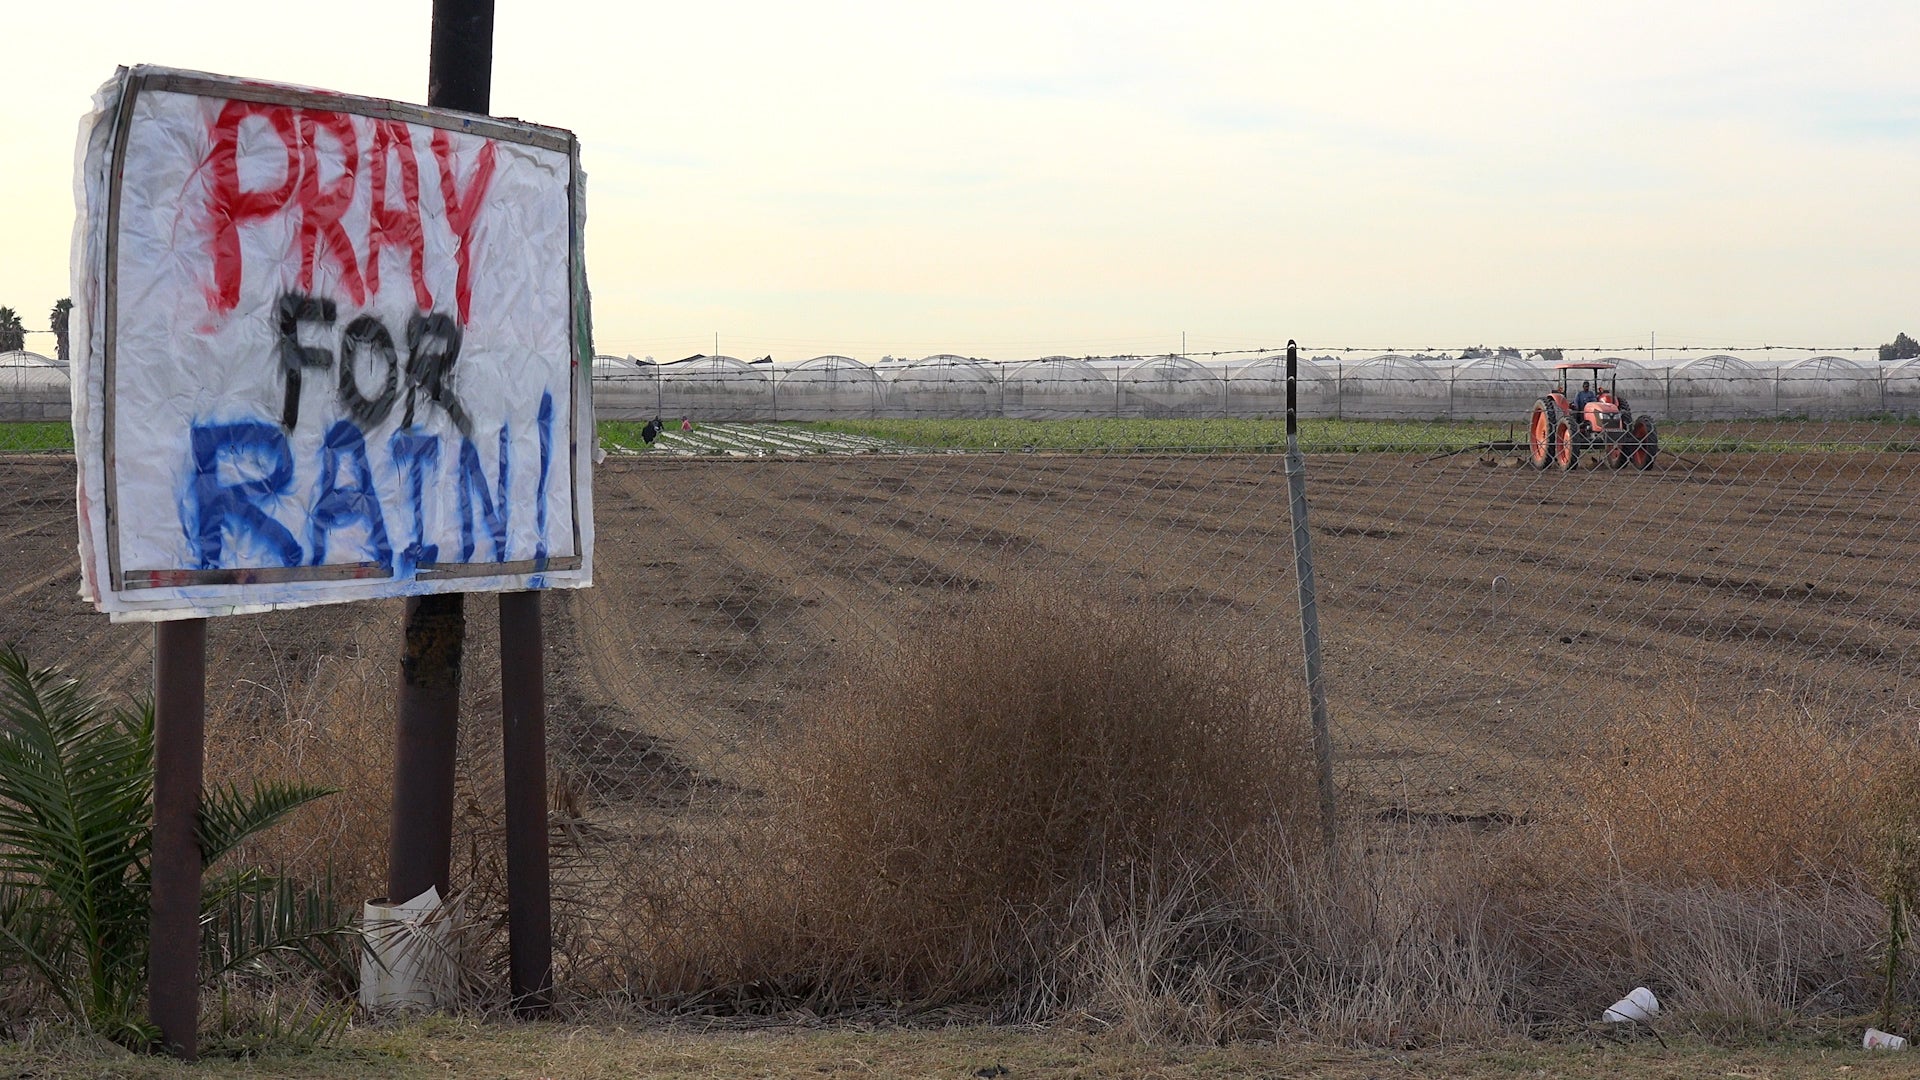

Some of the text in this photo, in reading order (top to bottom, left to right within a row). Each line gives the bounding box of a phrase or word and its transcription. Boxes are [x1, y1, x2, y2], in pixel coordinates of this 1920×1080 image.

[203, 99, 496, 325] PRAY
[276, 291, 474, 436] FOR
[183, 390, 553, 584] RAIN!
